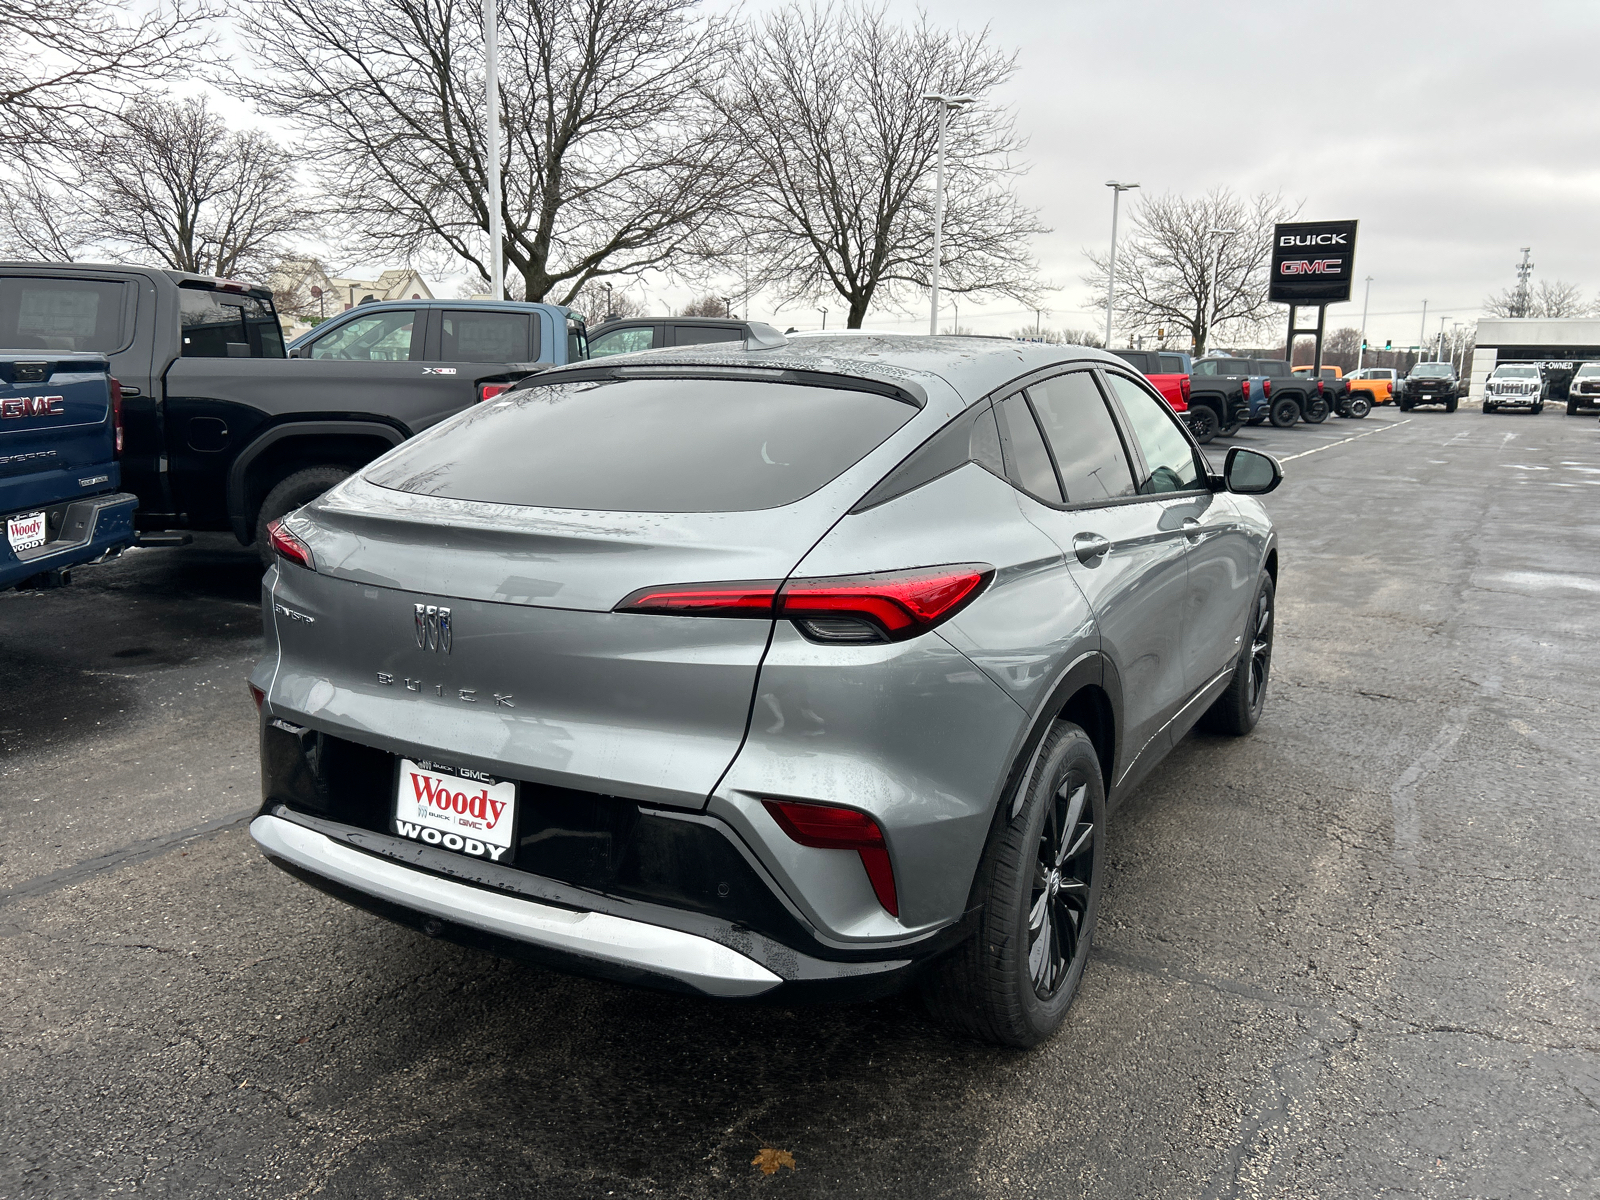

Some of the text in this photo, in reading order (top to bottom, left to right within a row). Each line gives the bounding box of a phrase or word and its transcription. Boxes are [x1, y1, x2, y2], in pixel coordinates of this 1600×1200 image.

[1280, 233, 1347, 246] BUICK
[1281, 259, 1342, 274] GMC
[0, 395, 64, 418] GMC
[10, 520, 42, 537] Woody
[377, 671, 515, 709] BUICK
[433, 762, 490, 782] BUICK GMC
[410, 772, 507, 829] Woody
[428, 811, 483, 831] BUICK GMC
[396, 820, 507, 861] WOODY
